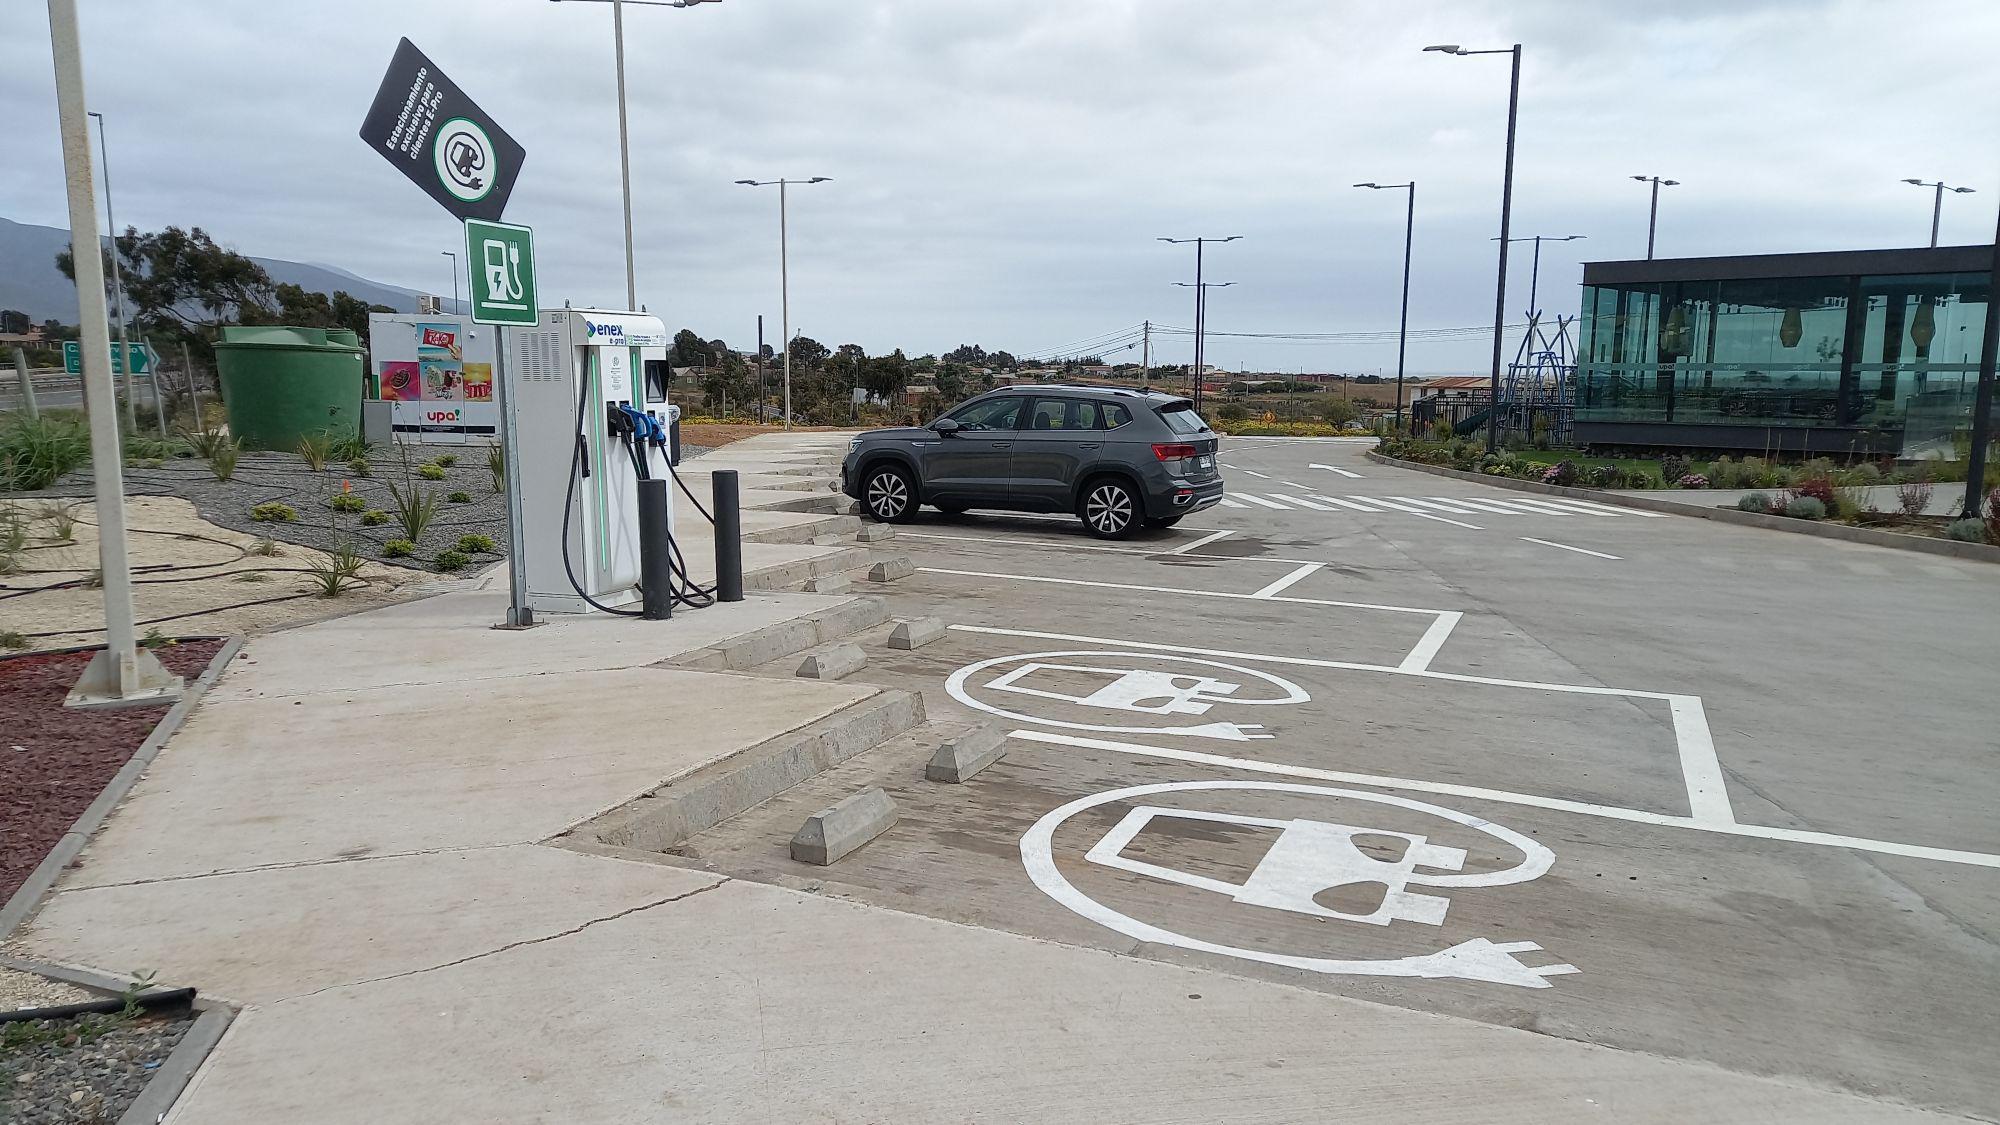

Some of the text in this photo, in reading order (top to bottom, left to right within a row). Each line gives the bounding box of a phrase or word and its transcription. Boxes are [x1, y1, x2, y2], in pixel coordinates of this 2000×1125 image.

[386, 67, 427, 150] Estacionamiento
[400, 82, 434, 152] exclusivo para
[410, 91, 443, 160] clientes E-Pro
[597, 324, 624, 337] enex
[427, 409, 460, 424] upa!
